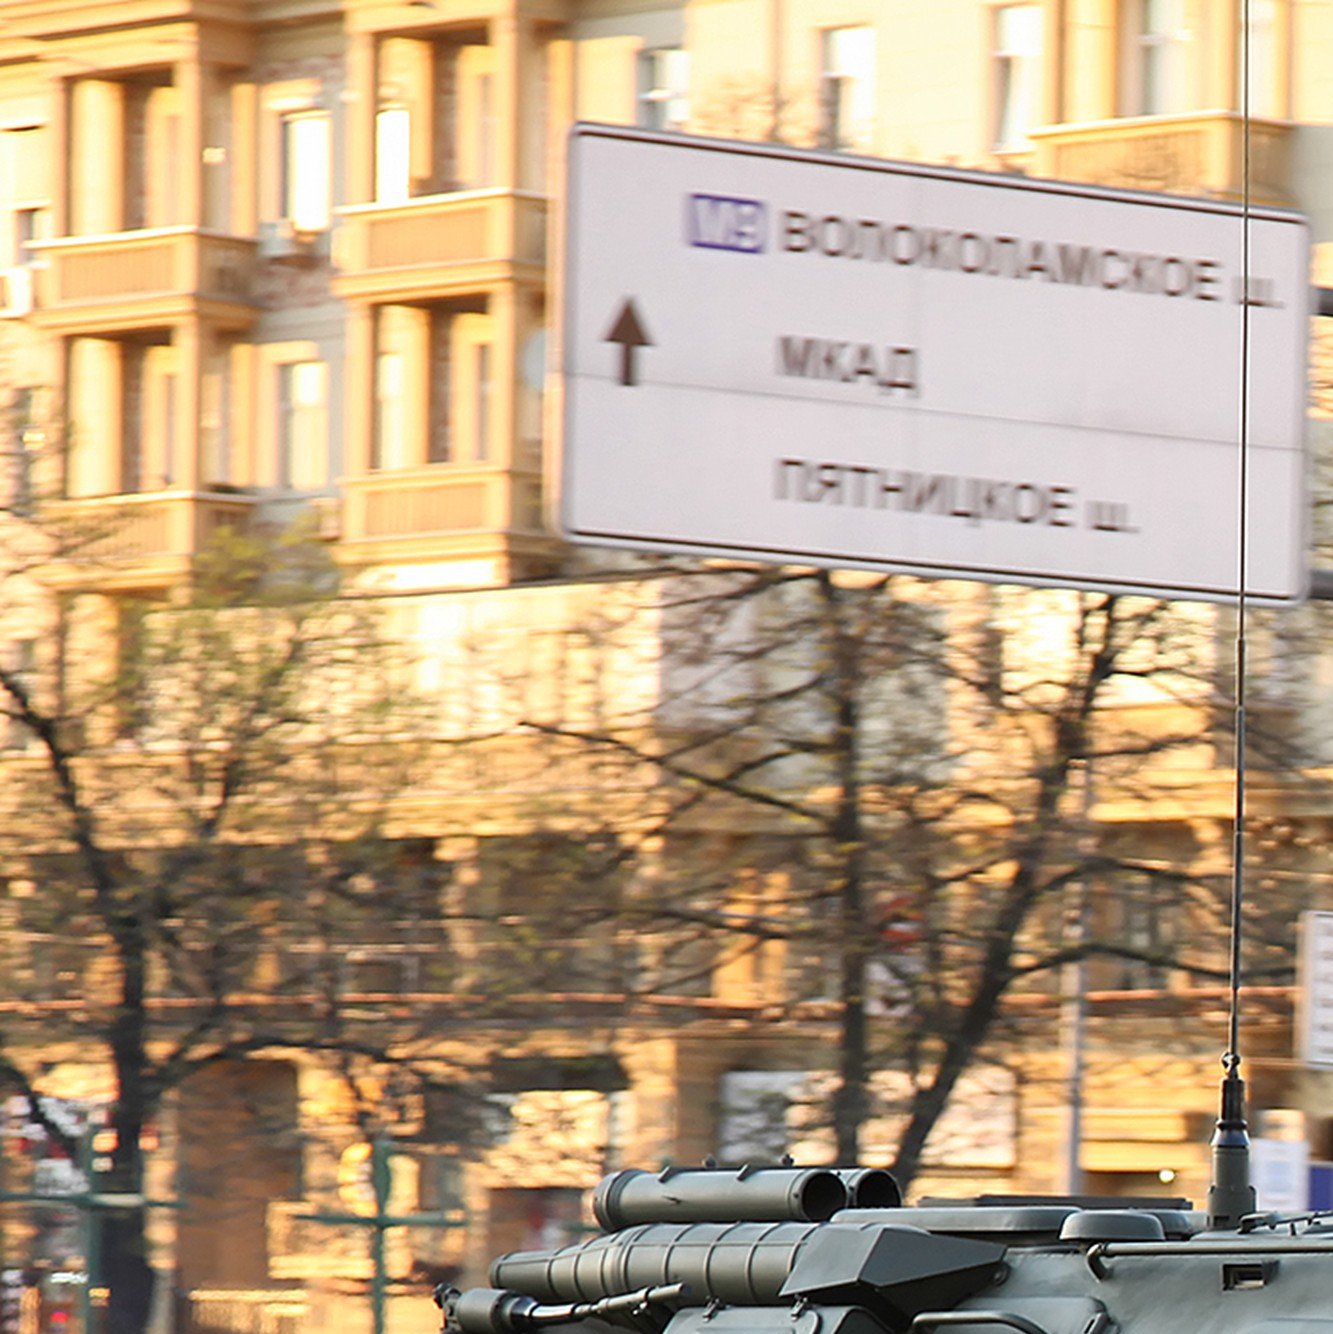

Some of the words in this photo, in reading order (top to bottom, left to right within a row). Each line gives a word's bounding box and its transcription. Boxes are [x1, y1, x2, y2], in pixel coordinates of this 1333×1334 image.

[782, 210, 1221, 301] ВОЛОКОЛАМСКОЕ
[1234, 277, 1284, 308] ш.
[778, 336, 918, 395] МКАД
[775, 458, 1076, 530] ПЯТНИЦКОЕ
[1085, 500, 1140, 533] ш.
